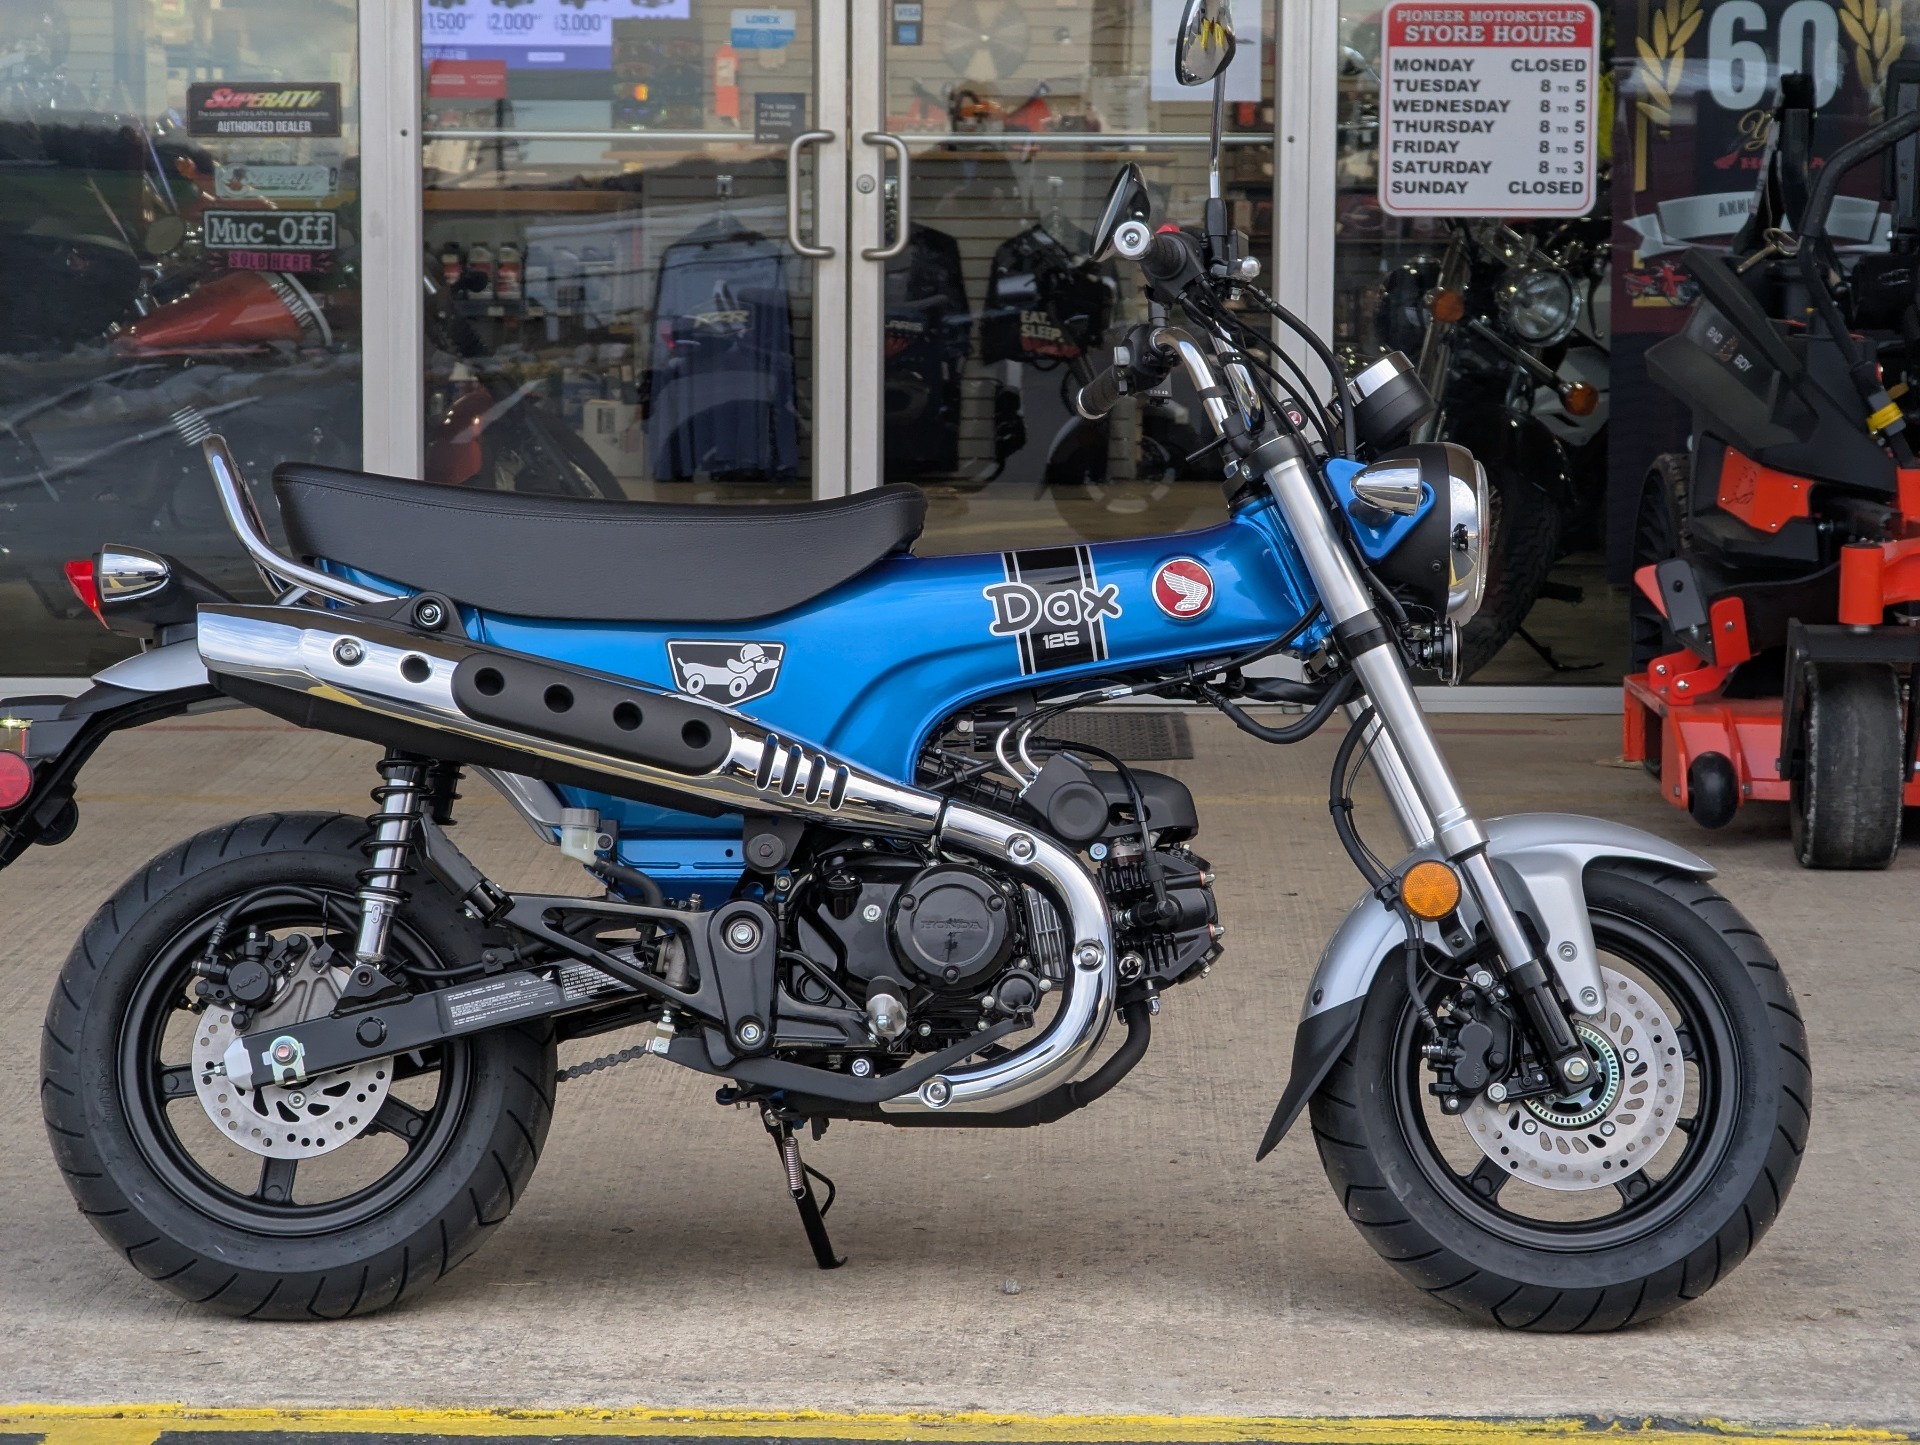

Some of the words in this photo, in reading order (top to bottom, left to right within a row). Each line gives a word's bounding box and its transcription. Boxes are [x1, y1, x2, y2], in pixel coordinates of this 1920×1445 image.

[896, 7, 920, 16] VISA
[1397, 10, 1465, 22] PIONEER
[1469, 10, 1585, 23] MOTORCYCLES
[1405, 26, 1485, 42] STORE
[1493, 26, 1576, 42] HOURS
[1708, 0, 1839, 110] 60
[1394, 59, 1475, 72] MONDAY
[1511, 59, 1587, 72] CLOSED
[1394, 79, 1481, 92] TUESDAY
[1540, 79, 1551, 92] 8
[1575, 79, 1586, 92] 5
[1393, 100, 1511, 113] WEDNESDAY
[1540, 100, 1550, 113] 8
[1556, 105, 1569, 113] TO
[1575, 100, 1585, 113] 5
[217, 121, 274, 132] AUTHORIZED
[276, 121, 312, 132] DEALER
[1393, 120, 1495, 133] THURSDAY
[1539, 120, 1549, 133] 8
[1575, 120, 1585, 133] 5
[1392, 140, 1460, 153] FRIDAY
[1539, 140, 1549, 153] 8
[1574, 140, 1584, 153] 5
[1392, 161, 1492, 174] SATURDAY
[1539, 161, 1549, 174] 8
[1574, 161, 1584, 174] 3
[1391, 181, 1469, 194] SUNDAY
[1508, 181, 1583, 194] CLOSED
[211, 216, 330, 244] Muc-Off
[230, 252, 267, 270] SOLD
[270, 253, 310, 271] HERE
[1020, 310, 1051, 326] EAT.
[1020, 324, 1065, 343] SLEEP.
[1706, 326, 1723, 344] BAD
[1733, 354, 1753, 371] BOY
[982, 582, 1123, 636] Dax
[1042, 631, 1080, 649] 125
[921, 919, 983, 930] HONDA
